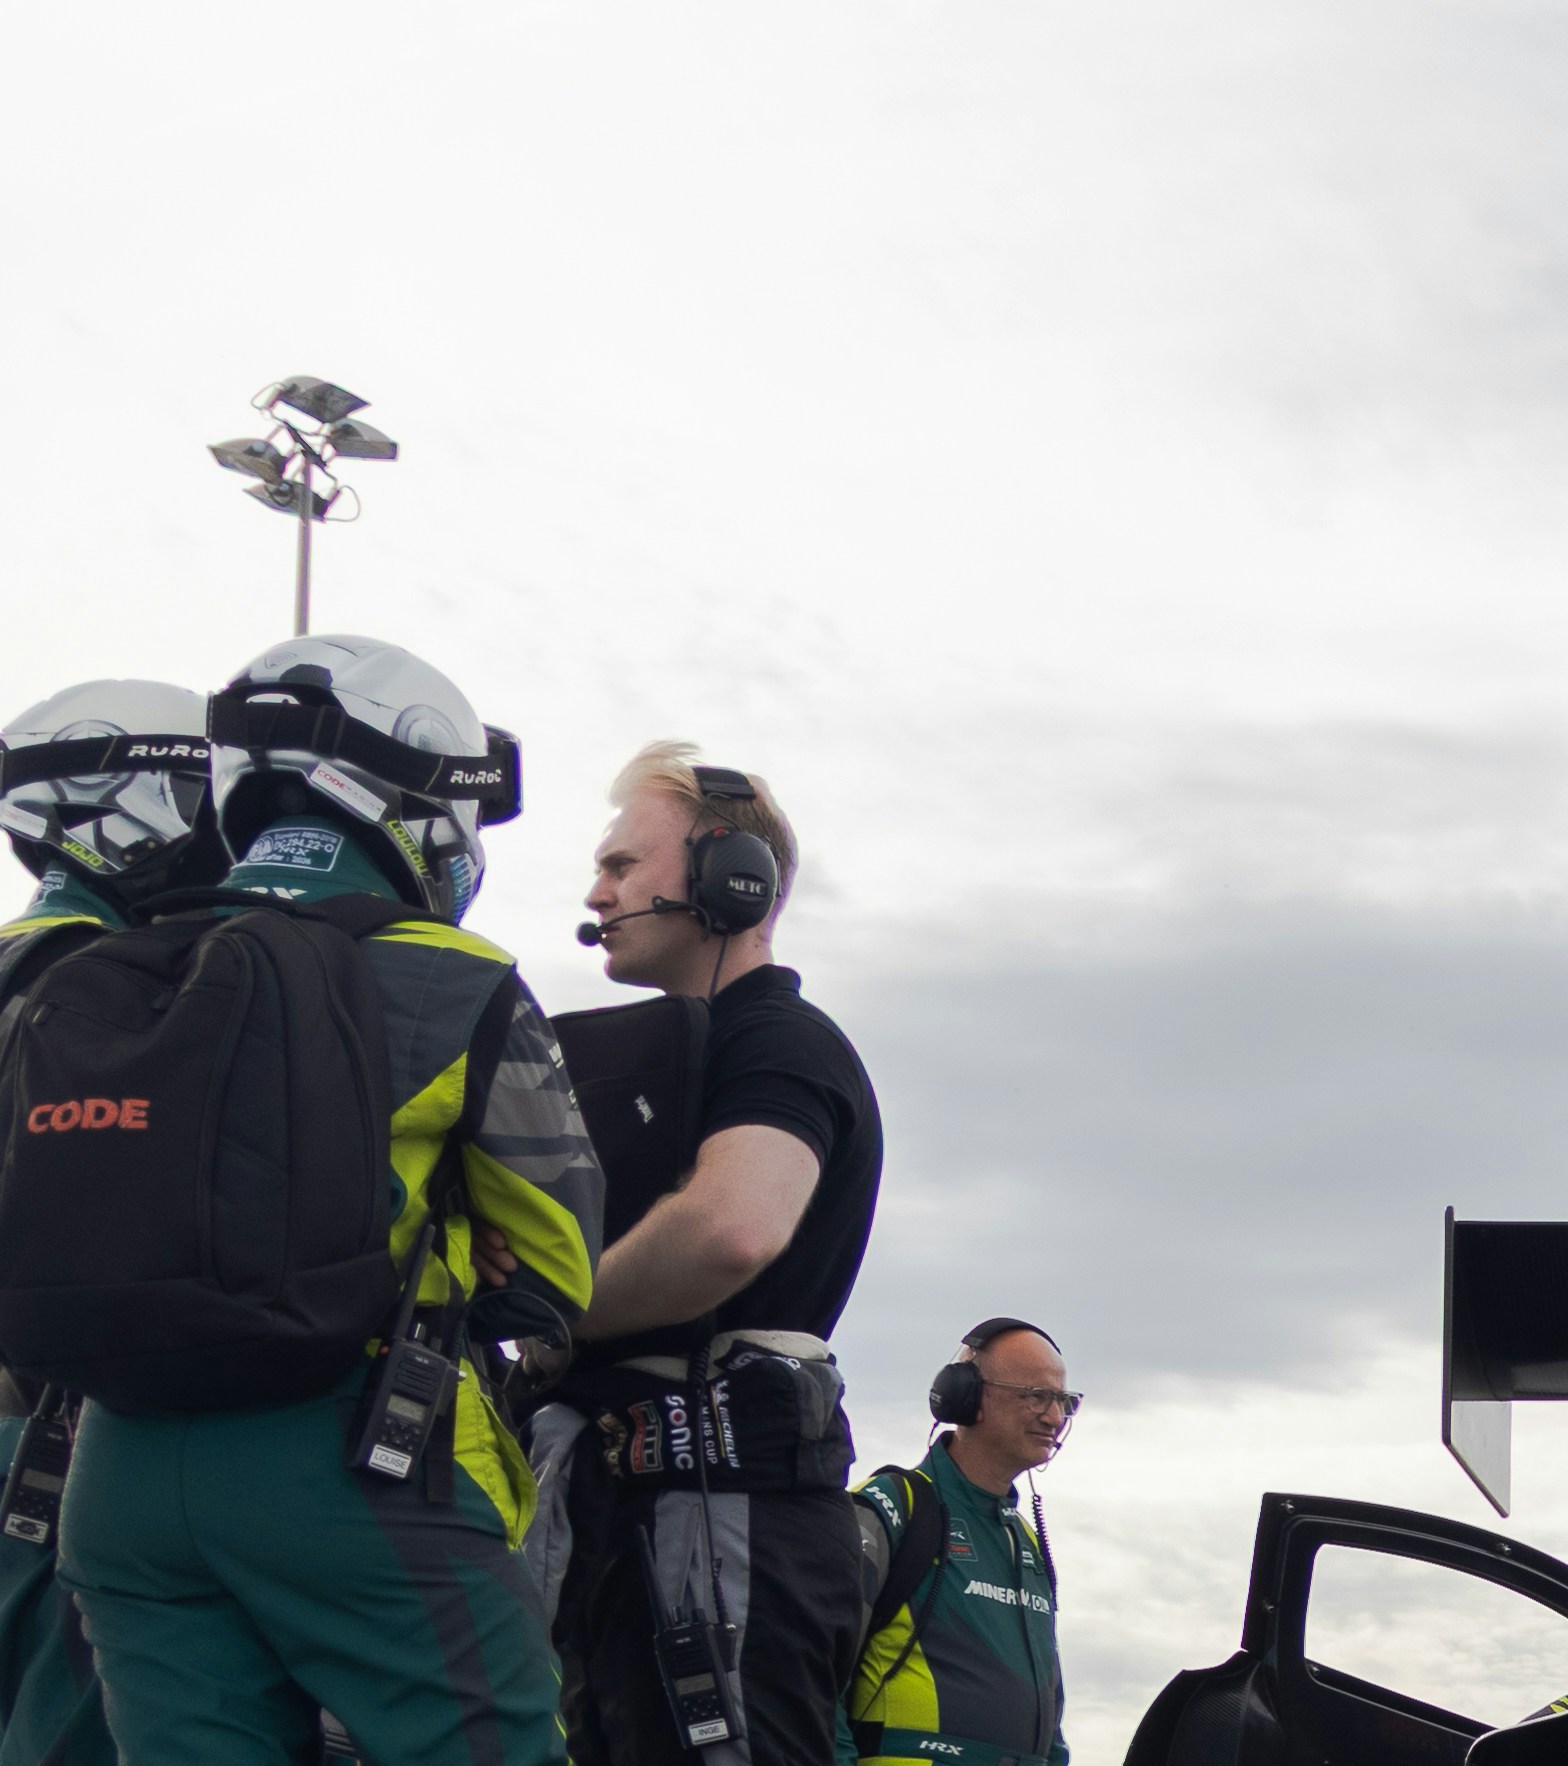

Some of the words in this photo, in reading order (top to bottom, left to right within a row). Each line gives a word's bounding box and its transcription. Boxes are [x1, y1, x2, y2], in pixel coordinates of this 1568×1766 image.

[62, 841, 104, 867] JOJO
[386, 818, 430, 879] LOULOU
[27, 1098, 151, 1134] CODE
[719, 1406, 741, 1468] MICHELIN
[866, 1486, 902, 1528] HRX
[919, 1740, 964, 1756] HRX
